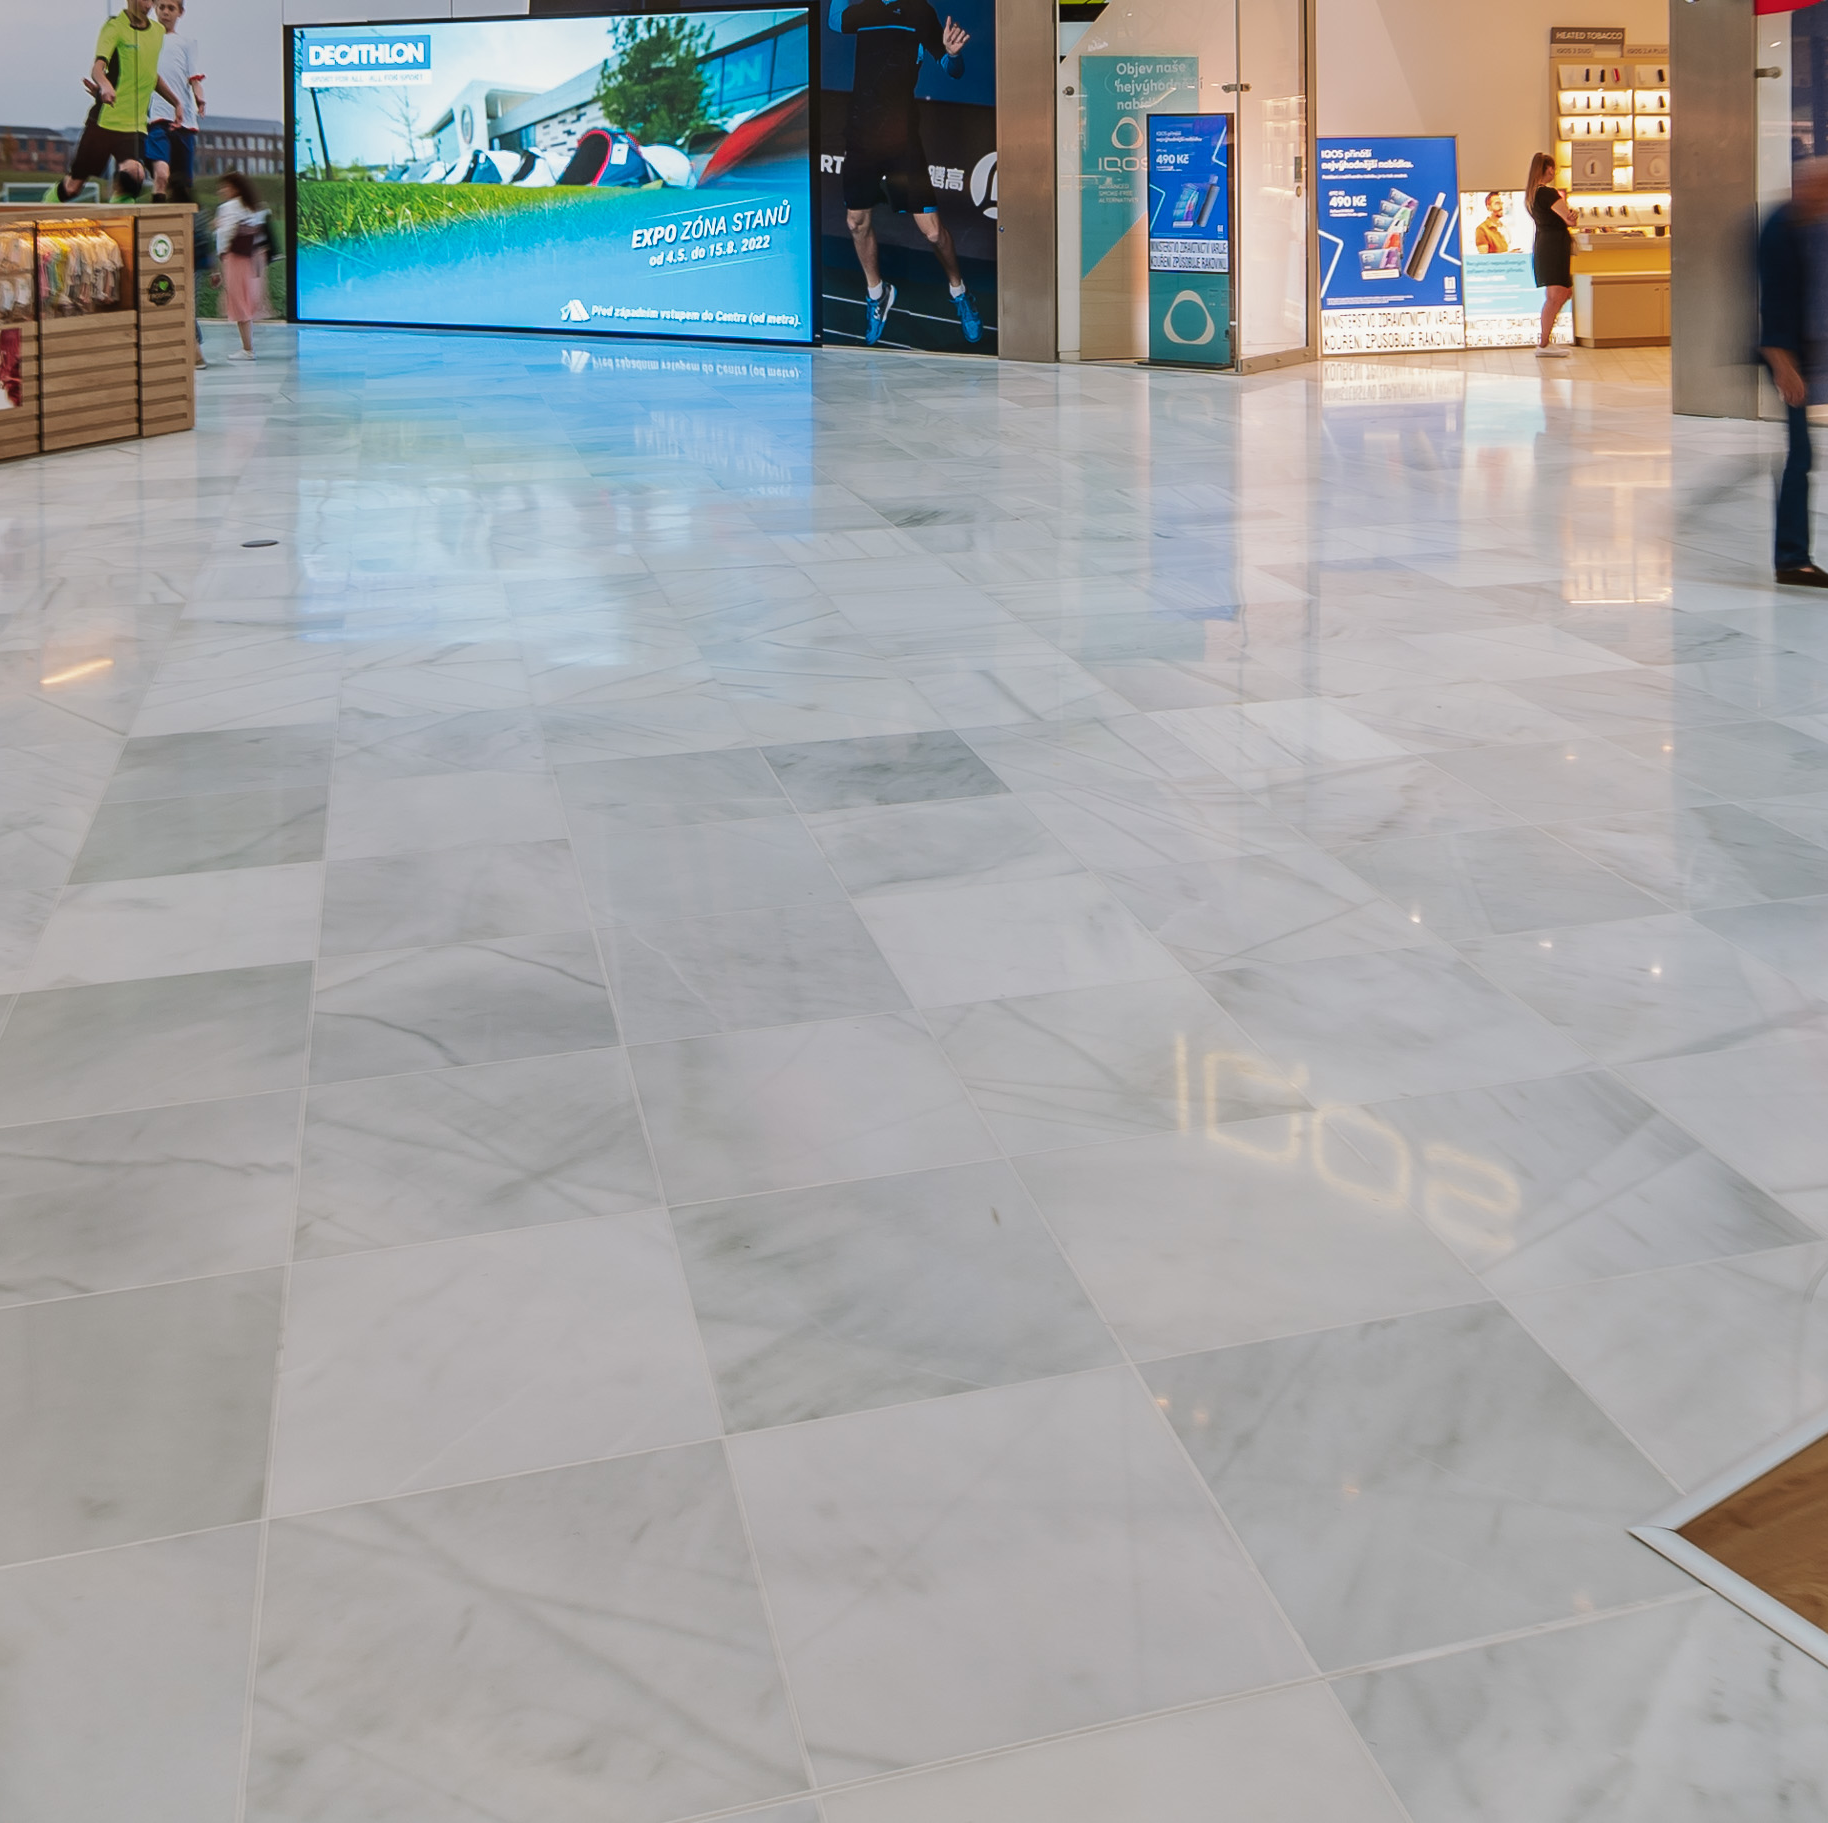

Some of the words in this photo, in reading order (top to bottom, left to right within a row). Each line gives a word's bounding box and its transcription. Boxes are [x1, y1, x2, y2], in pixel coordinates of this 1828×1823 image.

[308, 42, 425, 66] DECATHLON
[1116, 62, 1153, 78] Objev
[1156, 154, 1176, 165] 490
[1177, 153, 1190, 165] Kč
[1329, 196, 1352, 208] 490
[1353, 194, 1367, 207] Kč
[631, 223, 677, 249] EXPO
[680, 214, 727, 241] ZÓNA
[732, 199, 791, 232] STANŮ
[648, 251, 665, 267] od
[665, 248, 688, 264] 4.5.
[691, 245, 706, 260] do
[709, 240, 738, 257] 15.8.
[741, 234, 771, 253] 2022
[701, 309, 714, 322] do
[715, 310, 747, 323] Centra
